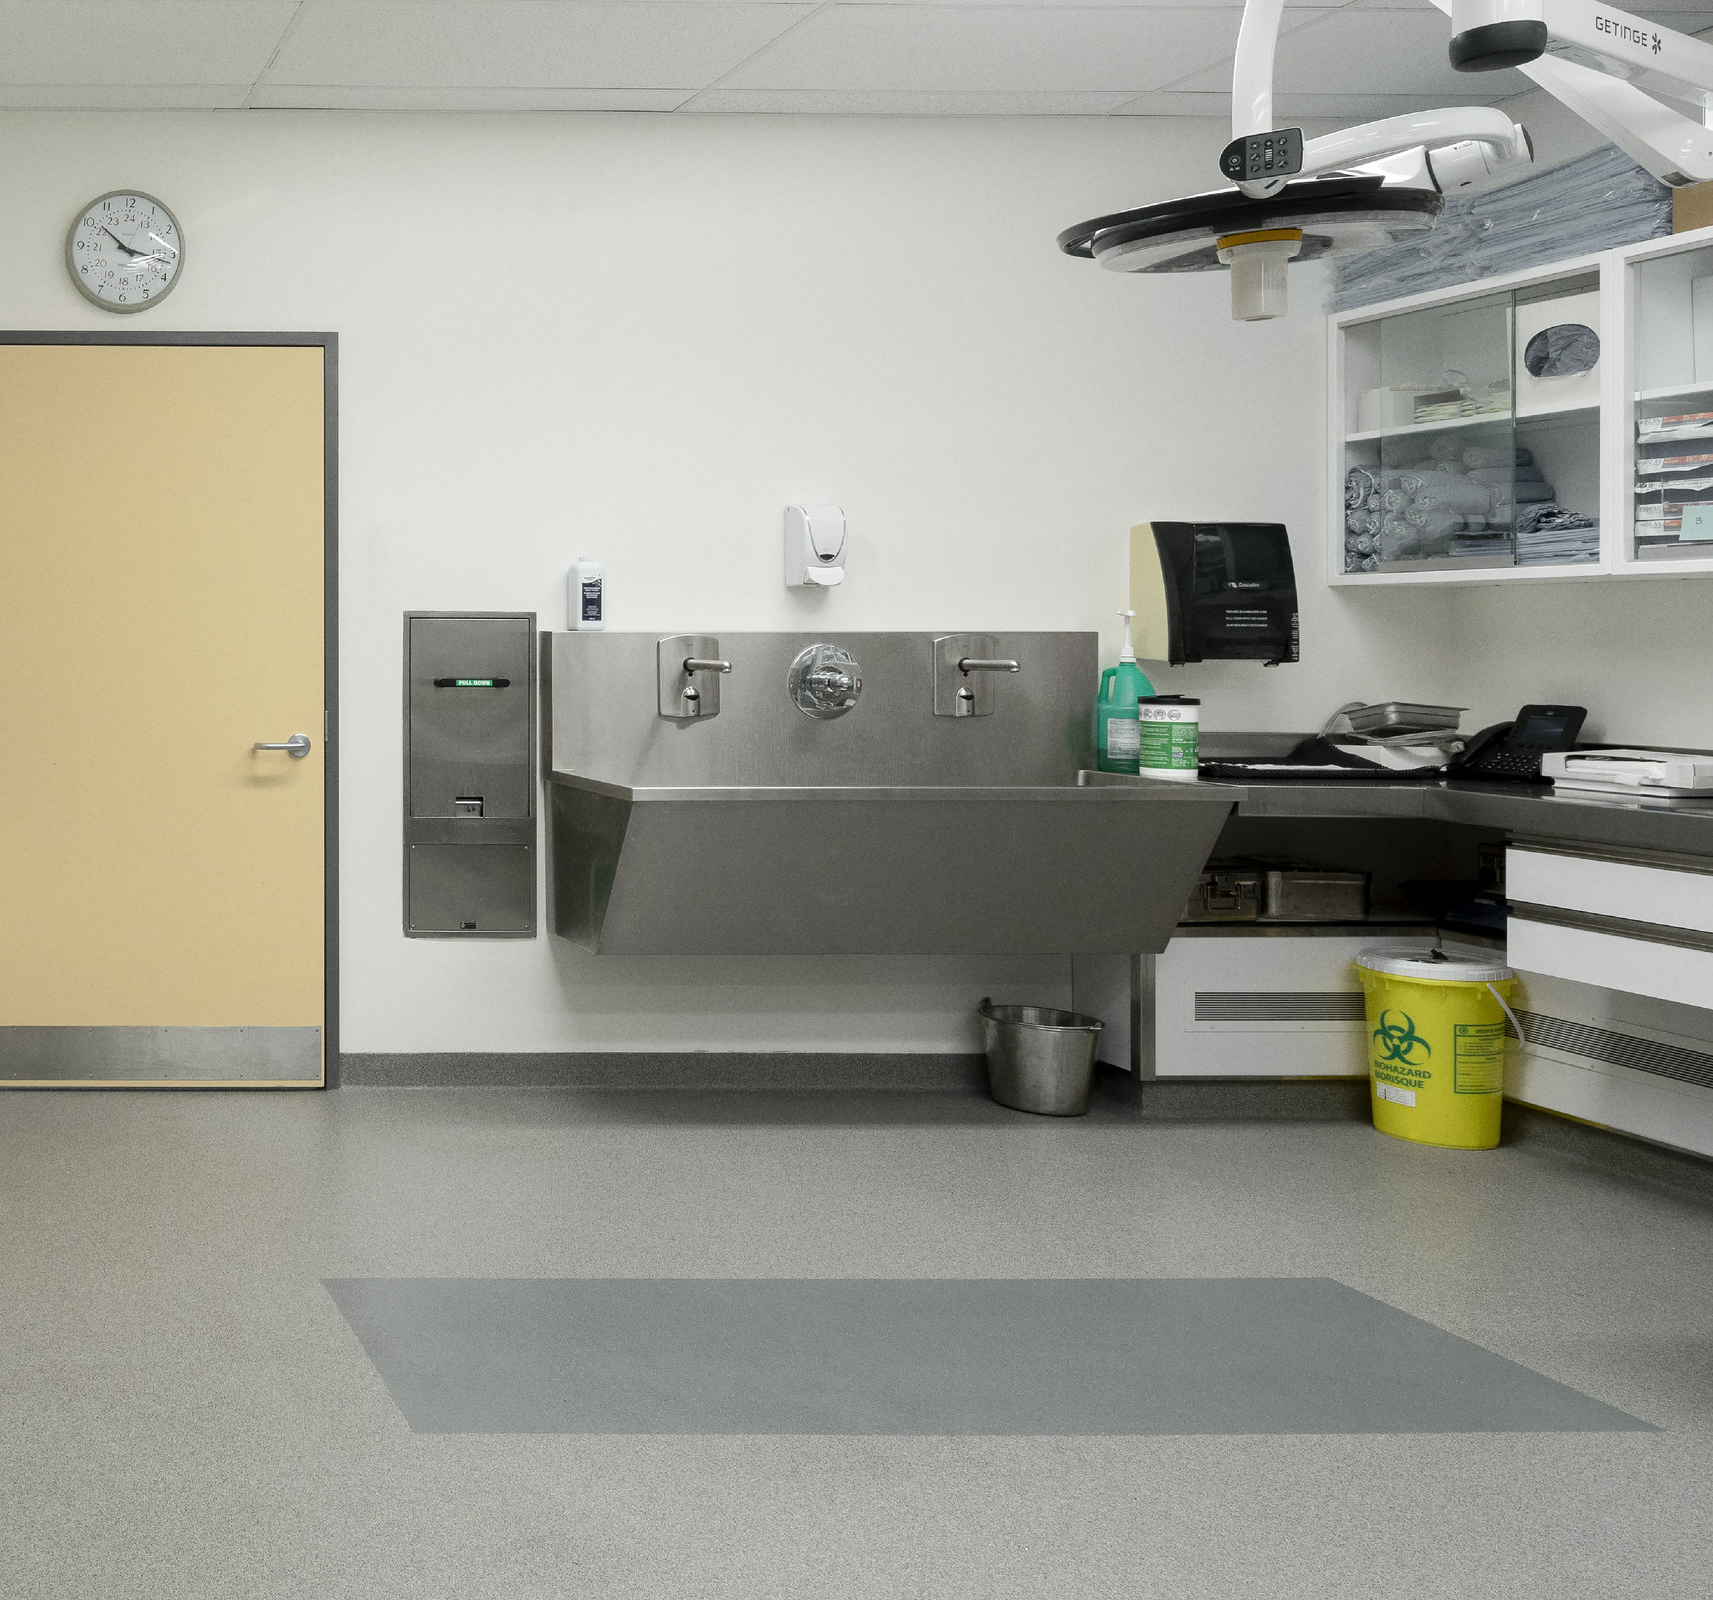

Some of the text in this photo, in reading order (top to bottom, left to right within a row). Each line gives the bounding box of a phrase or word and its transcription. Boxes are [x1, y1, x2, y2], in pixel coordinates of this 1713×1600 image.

[1595, 16, 1648, 47] GETINGE
[103, 201, 111, 211] 11
[125, 197, 136, 208] 12
[151, 206, 155, 215] 1
[83, 216, 95, 227] 10
[107, 216, 120, 226] 23
[124, 213, 136, 223] 24
[140, 220, 150, 229] 13
[165, 224, 172, 235] 2
[96, 227, 107, 236] 22
[76, 240, 85, 251] 9
[92, 242, 102, 251] 21
[168, 249, 176, 259] 3
[94, 258, 108, 267] 20
[80, 264, 89, 274] 8
[104, 270, 115, 279] 19
[135, 274, 145, 282] 17
[160, 272, 167, 282] 4
[119, 277, 129, 286] 18
[97, 285, 104, 294] 7
[142, 289, 150, 299] 5
[118, 293, 127, 302] 6
[1374, 1059, 1432, 1080] BIOHAZARD
[1374, 1069, 1425, 1089] BIORISQUE
